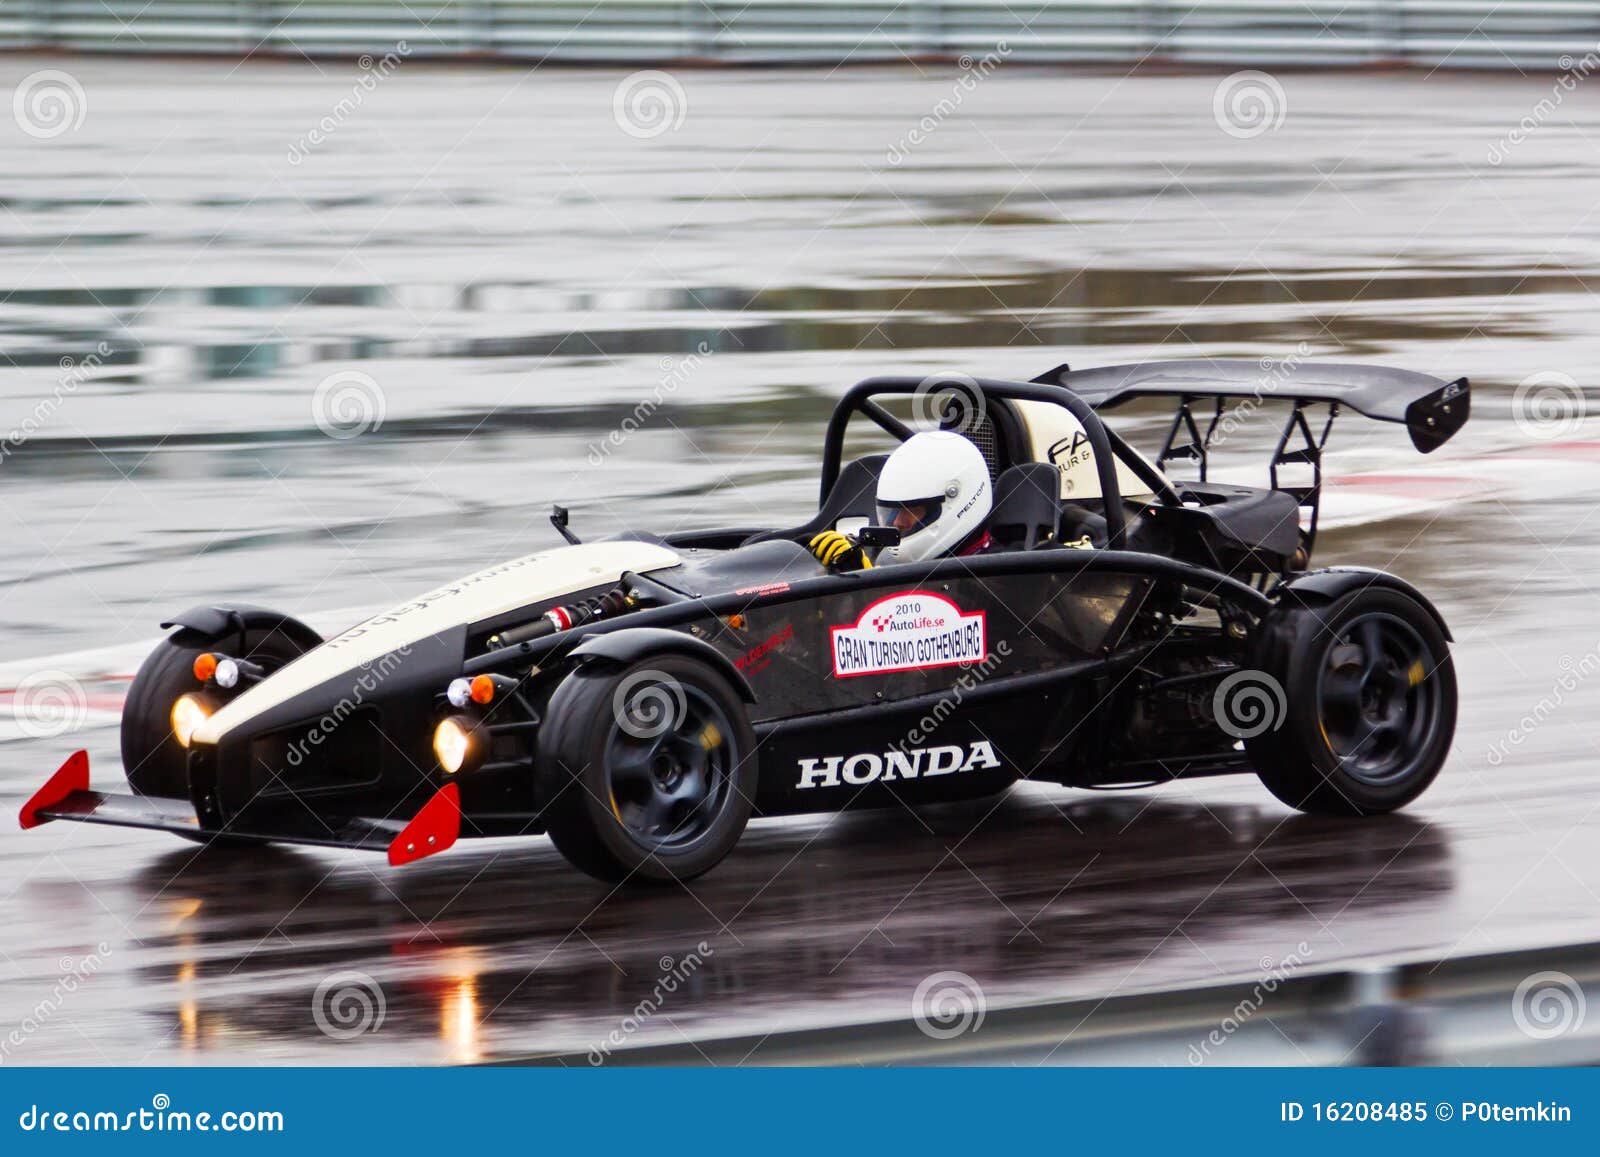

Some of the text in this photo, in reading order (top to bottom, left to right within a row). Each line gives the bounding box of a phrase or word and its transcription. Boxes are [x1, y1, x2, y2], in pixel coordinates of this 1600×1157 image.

[889, 617, 945, 632] AutoLife.se
[895, 602, 921, 615] 2010
[837, 620, 980, 670] GRAN TURISMO GOTHENBURG
[795, 740, 1001, 789] HONDA
